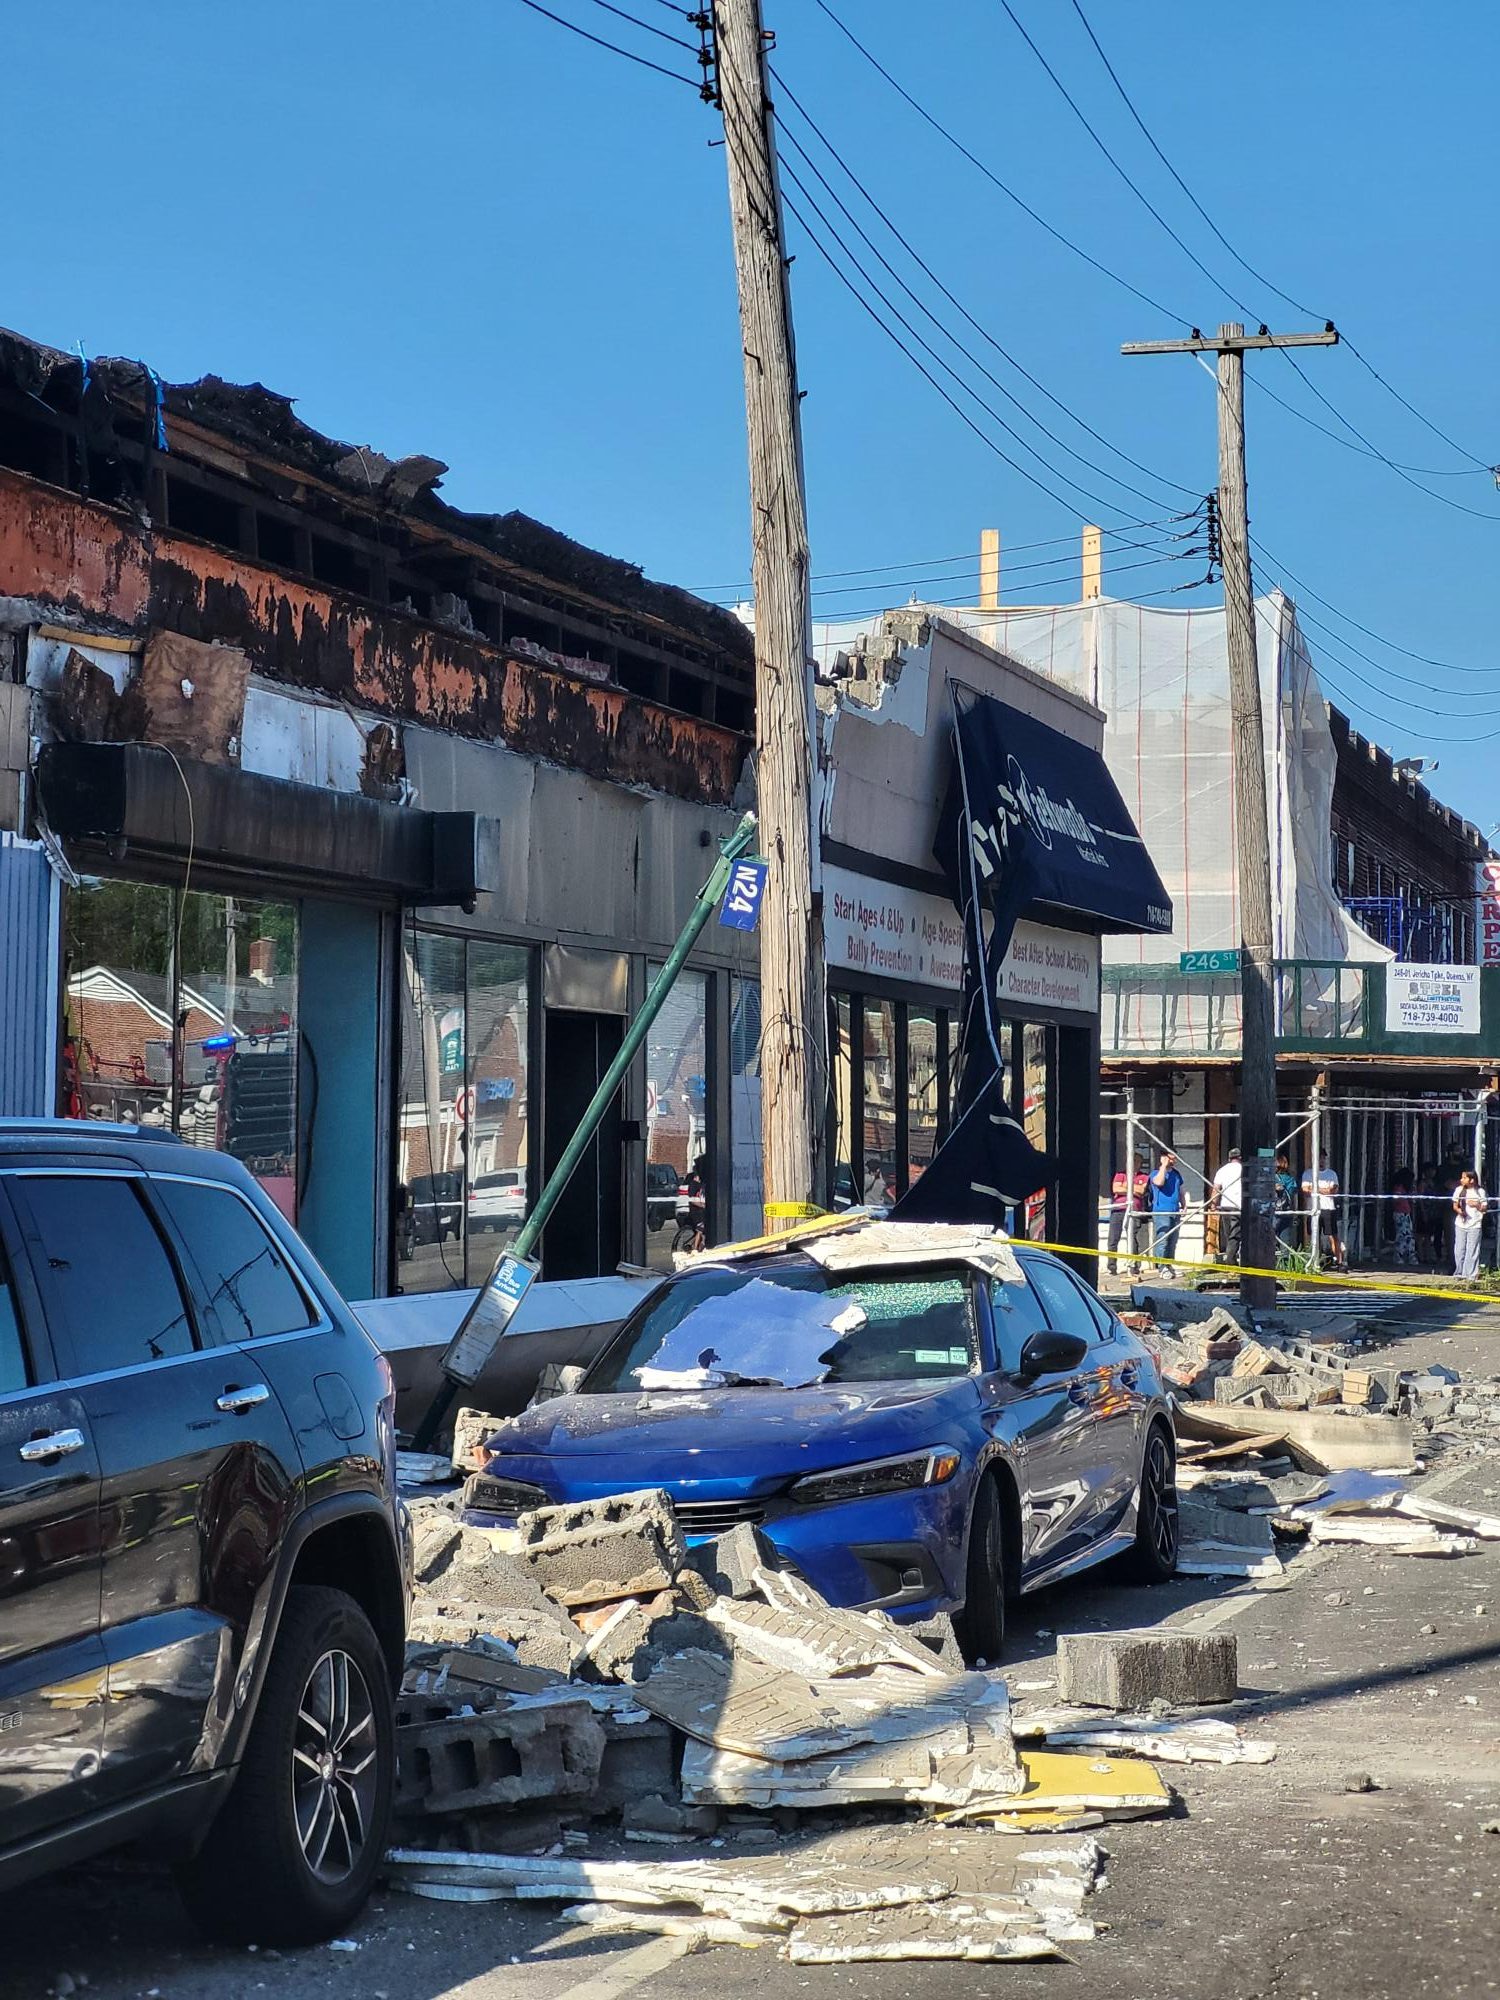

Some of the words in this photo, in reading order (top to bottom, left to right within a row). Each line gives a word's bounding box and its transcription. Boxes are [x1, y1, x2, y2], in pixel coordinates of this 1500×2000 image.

[729, 866, 758, 913] N24
[834, 892, 855, 922] Start
[858, 900, 877, 932] Ages
[880, 906, 885, 931] 4
[922, 916, 936, 946] Age
[847, 936, 868, 969] Bully
[871, 942, 912, 972] Prevention
[1013, 939, 1027, 963] Best
[1029, 942, 1044, 965] After
[1045, 946, 1065, 969] School
[1067, 951, 1089, 978] Activity
[1185, 953, 1219, 970] 246
[1223, 952, 1233, 960] ST
[930, 954, 962, 980] Awesom
[1412, 969, 1430, 979] Jericho
[1467, 973, 1474, 981] NY
[1008, 971, 1040, 996] Character
[1041, 977, 1080, 1004] Development
[1409, 982, 1460, 995] STEEL
[1402, 1012, 1459, 1023] 718-739-4000
[493, 1280, 517, 1295] Arrivals
[509, 1279, 520, 1289] Bus
[0, 1711, 22, 1732] EE
